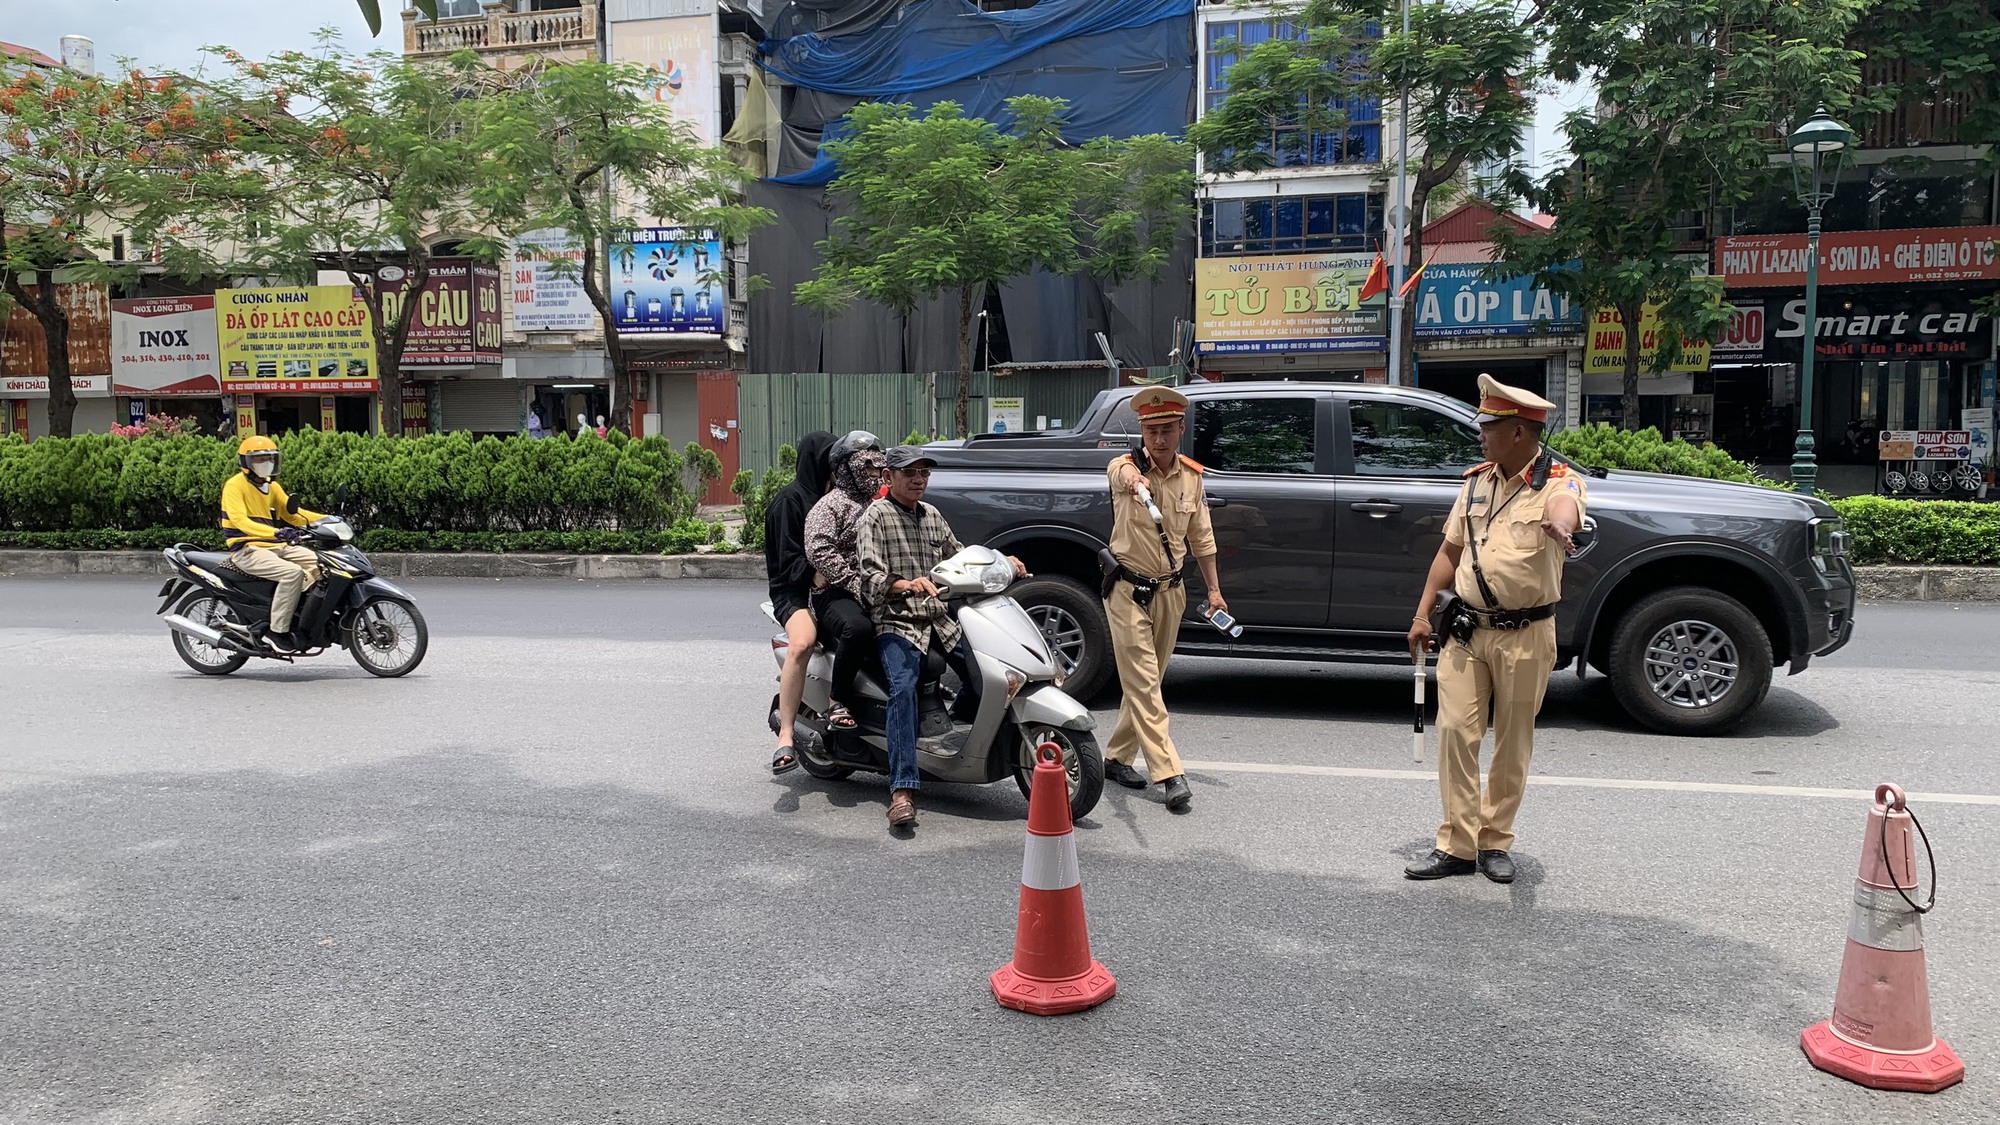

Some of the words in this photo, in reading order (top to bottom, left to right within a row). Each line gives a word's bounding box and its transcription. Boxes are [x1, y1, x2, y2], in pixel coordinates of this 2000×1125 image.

[633, 229, 656, 243] ĐIỆN
[1725, 238, 1761, 248] Smart
[1723, 249, 1759, 275] PHAY
[1762, 248, 1808, 273] LAZAN
[1830, 246, 1858, 271] SƠN
[1860, 246, 1880, 269] DA
[1894, 235, 1921, 268] GHẾ
[1924, 239, 1956, 272] ĐIỆN
[1960, 237, 1970, 267] Ô
[1974, 236, 1994, 266] TÔ
[440, 266, 466, 274] MÂM
[1229, 262, 1252, 273] NỘI
[1257, 260, 1294, 271] THẤT
[1299, 259, 1337, 270] HÙNG
[1422, 266, 1447, 279] CỬA
[516, 266, 531, 284] SẢN
[232, 292, 272, 304] CƯỜNG
[480, 280, 496, 313] ĐỒ
[514, 285, 534, 303] XUẤT
[1205, 275, 1269, 316] TỦ
[1415, 286, 1442, 324] Á
[1454, 280, 1499, 323] ỐP
[175, 304, 193, 312] BIÊN
[421, 282, 468, 327] CÂU
[226, 309, 246, 329] ĐÁ
[250, 306, 268, 329] ỐP
[273, 308, 299, 328] LÁT
[304, 310, 333, 328] CAO
[337, 304, 366, 326] CẤP
[1775, 300, 1909, 338] Smart
[1919, 312, 1981, 334] car
[139, 330, 189, 347] INOX
[477, 318, 500, 348] CÂU
[1595, 327, 1623, 350] BÁNH
[1592, 352, 1610, 367] CƠM
[1612, 356, 1627, 366] RAN
[1685, 351, 1702, 366] XÀO
[7, 381, 24, 389] KÍNH
[25, 380, 46, 389] CHÀO
[71, 379, 91, 388] HÁCH
[130, 402, 144, 416] 622
[403, 400, 426, 419] NƯỚC
[240, 411, 252, 428] ĐÁ
[324, 414, 333, 430] ĐÁ
[1918, 434, 1942, 443] PHAY
[1947, 433, 1966, 443] SƠN
